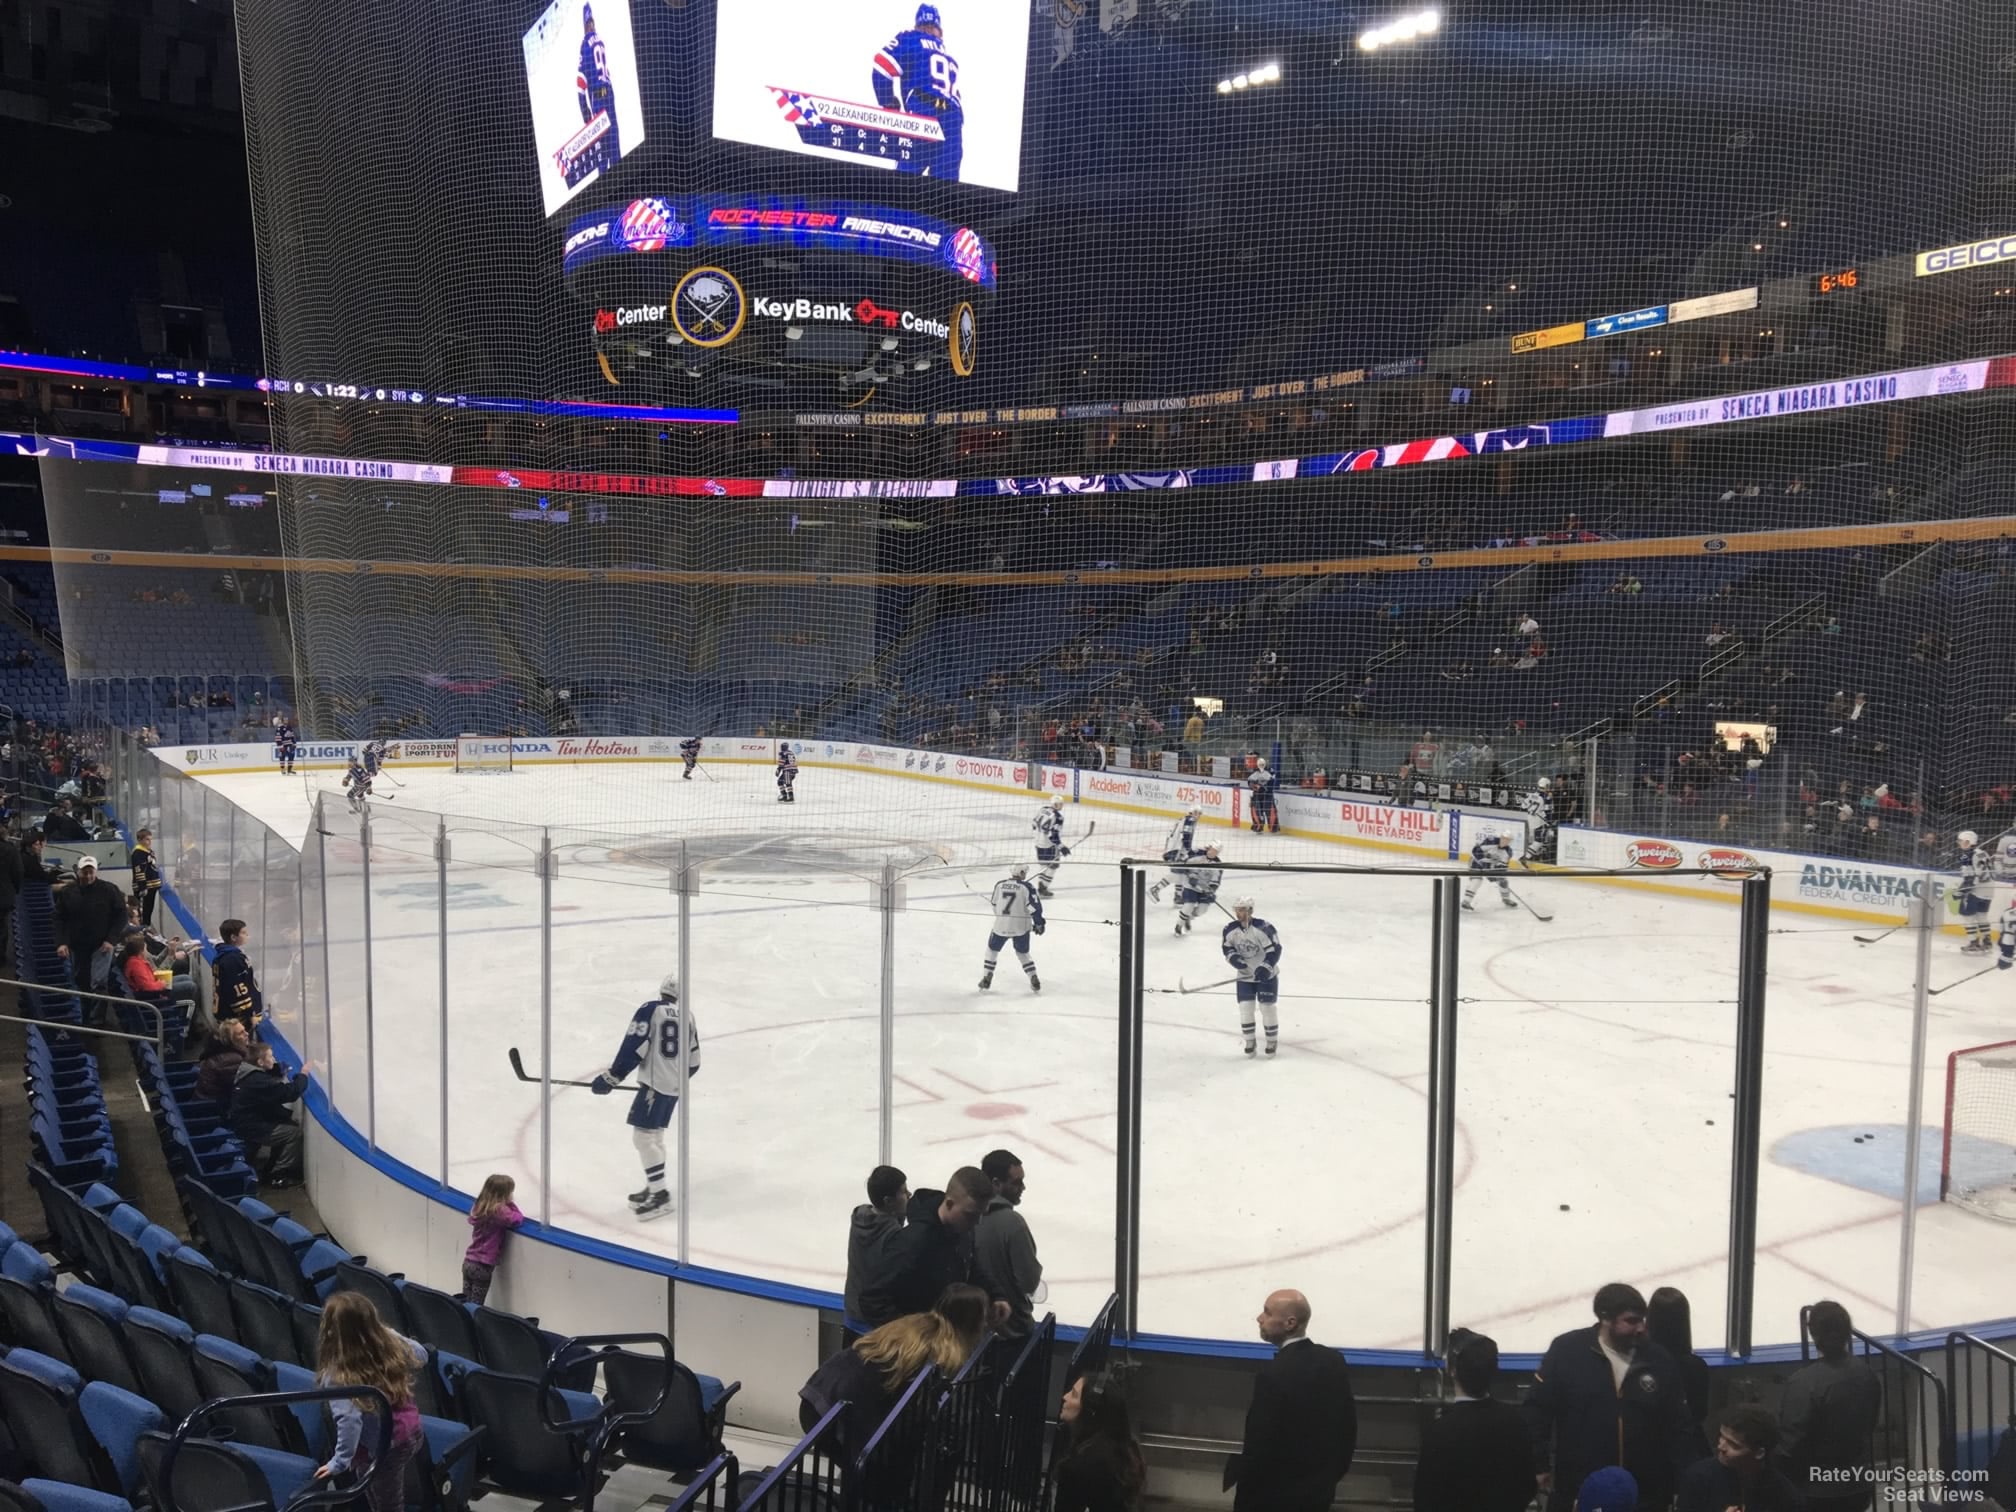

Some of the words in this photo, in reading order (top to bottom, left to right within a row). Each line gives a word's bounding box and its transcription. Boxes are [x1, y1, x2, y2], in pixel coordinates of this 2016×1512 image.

[818, 103, 830, 115] 92
[832, 107, 880, 123] ALEXANDER
[879, 115, 920, 131] NYLANDER
[924, 123, 939, 135] RW
[832, 137, 841, 147] 31
[858, 142, 864, 151] 4
[880, 146, 886, 155] 9
[901, 150, 910, 159] 13
[708, 208, 837, 227] ROCHESTER
[842, 216, 942, 247] AMERICANS
[1820, 270, 1857, 294] 6:46
[616, 304, 667, 326] Center
[753, 296, 853, 322] KeyBank
[901, 311, 950, 340] Center
[273, 380, 290, 392] RCH
[294, 382, 304, 393] 0
[326, 384, 357, 398] 1:22
[375, 389, 385, 400] 0
[1122, 400, 1159, 413] FALLSVIEW
[1159, 397, 1187, 411] CASINO
[1189, 389, 1244, 408] EXCITEMENT
[1252, 383, 1276, 400] JUST
[1278, 380, 1305, 396] OVER
[1312, 376, 1329, 391] THE
[1330, 368, 1366, 388] BORDER
[391, 390, 407, 402] SYR
[1655, 408, 1696, 425] PRESENTED
[1699, 407, 1709, 420] BY
[1722, 394, 1770, 420] SENECA
[1777, 385, 1836, 413] NIAGARA
[1844, 376, 1897, 405] CASINO
[833, 414, 861, 425] CASINO
[864, 412, 927, 425] EXCITEMENT
[934, 411, 958, 425] JUST
[961, 411, 988, 423] OVER
[996, 410, 1015, 422] THE
[1017, 407, 1058, 421] BORDER
[190, 454, 231, 466] PRESENTED
[233, 457, 243, 467] BY
[254, 455, 297, 473] SENECA
[302, 458, 350, 476] NIAGARA
[355, 462, 393, 478] CASINO
[1271, 462, 1281, 478] VS
[199, 749, 218, 760] UR
[309, 746, 355, 758] LIGHT
[483, 743, 552, 754] HONDA
[969, 762, 1004, 780] TOYOTA
[1089, 776, 1132, 795] Accident?
[1176, 786, 1222, 806] 475-1100
[1342, 803, 1394, 826] BULLY
[1400, 811, 1440, 833] HILL
[1357, 823, 1423, 842] VINEYARDS
[1002, 891, 1017, 915] 7
[1799, 886, 1847, 902] FEDERAL
[1852, 892, 1897, 908] CREDIT
[233, 982, 249, 998] 15
